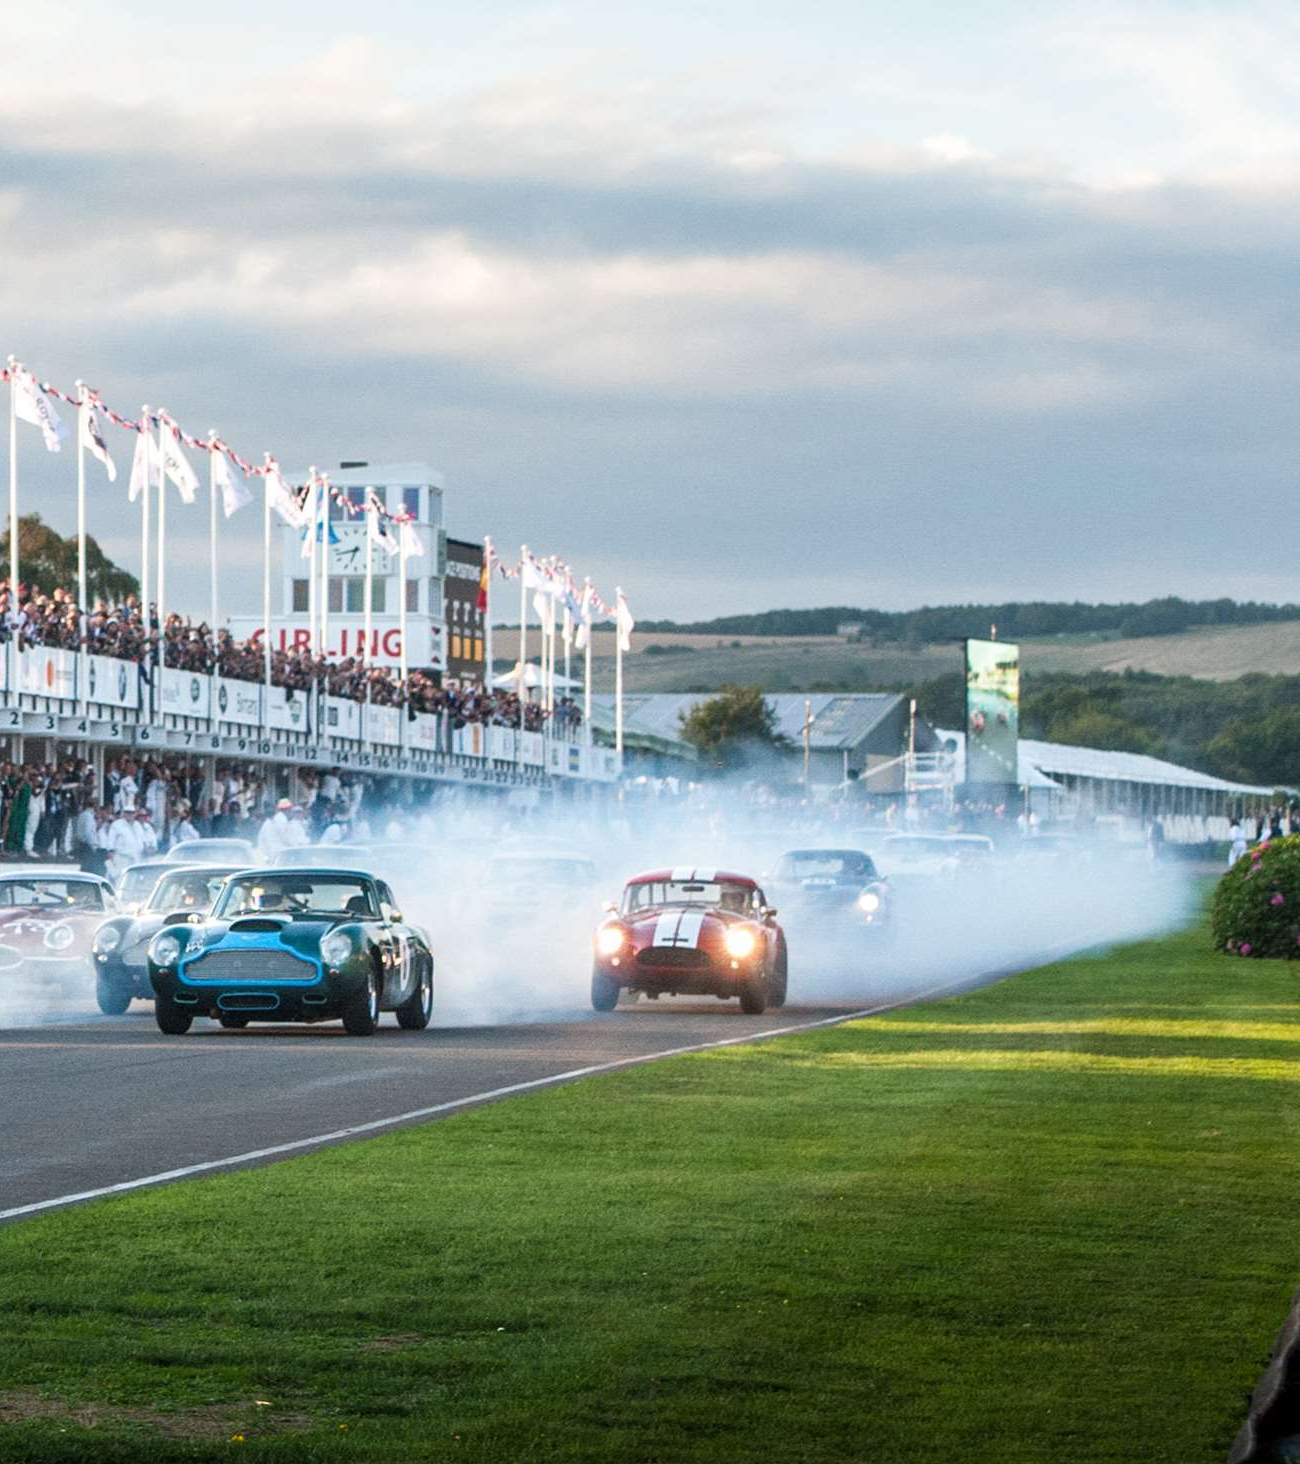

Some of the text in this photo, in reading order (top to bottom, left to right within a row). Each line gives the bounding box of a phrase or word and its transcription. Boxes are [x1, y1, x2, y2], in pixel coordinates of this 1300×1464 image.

[10, 711, 19, 725] 2
[46, 716, 54, 730] 3
[77, 721, 86, 733] 4
[111, 724, 119, 737] 5
[141, 727, 149, 740] 6
[185, 733, 192, 745] 7
[211, 737, 220, 749] 8
[238, 739, 246, 751] 9
[257, 742, 270, 754] 10
[286, 745, 295, 757] 11
[305, 749, 317, 760] 12
[336, 752, 348, 763] 14
[358, 755, 370, 766] 15
